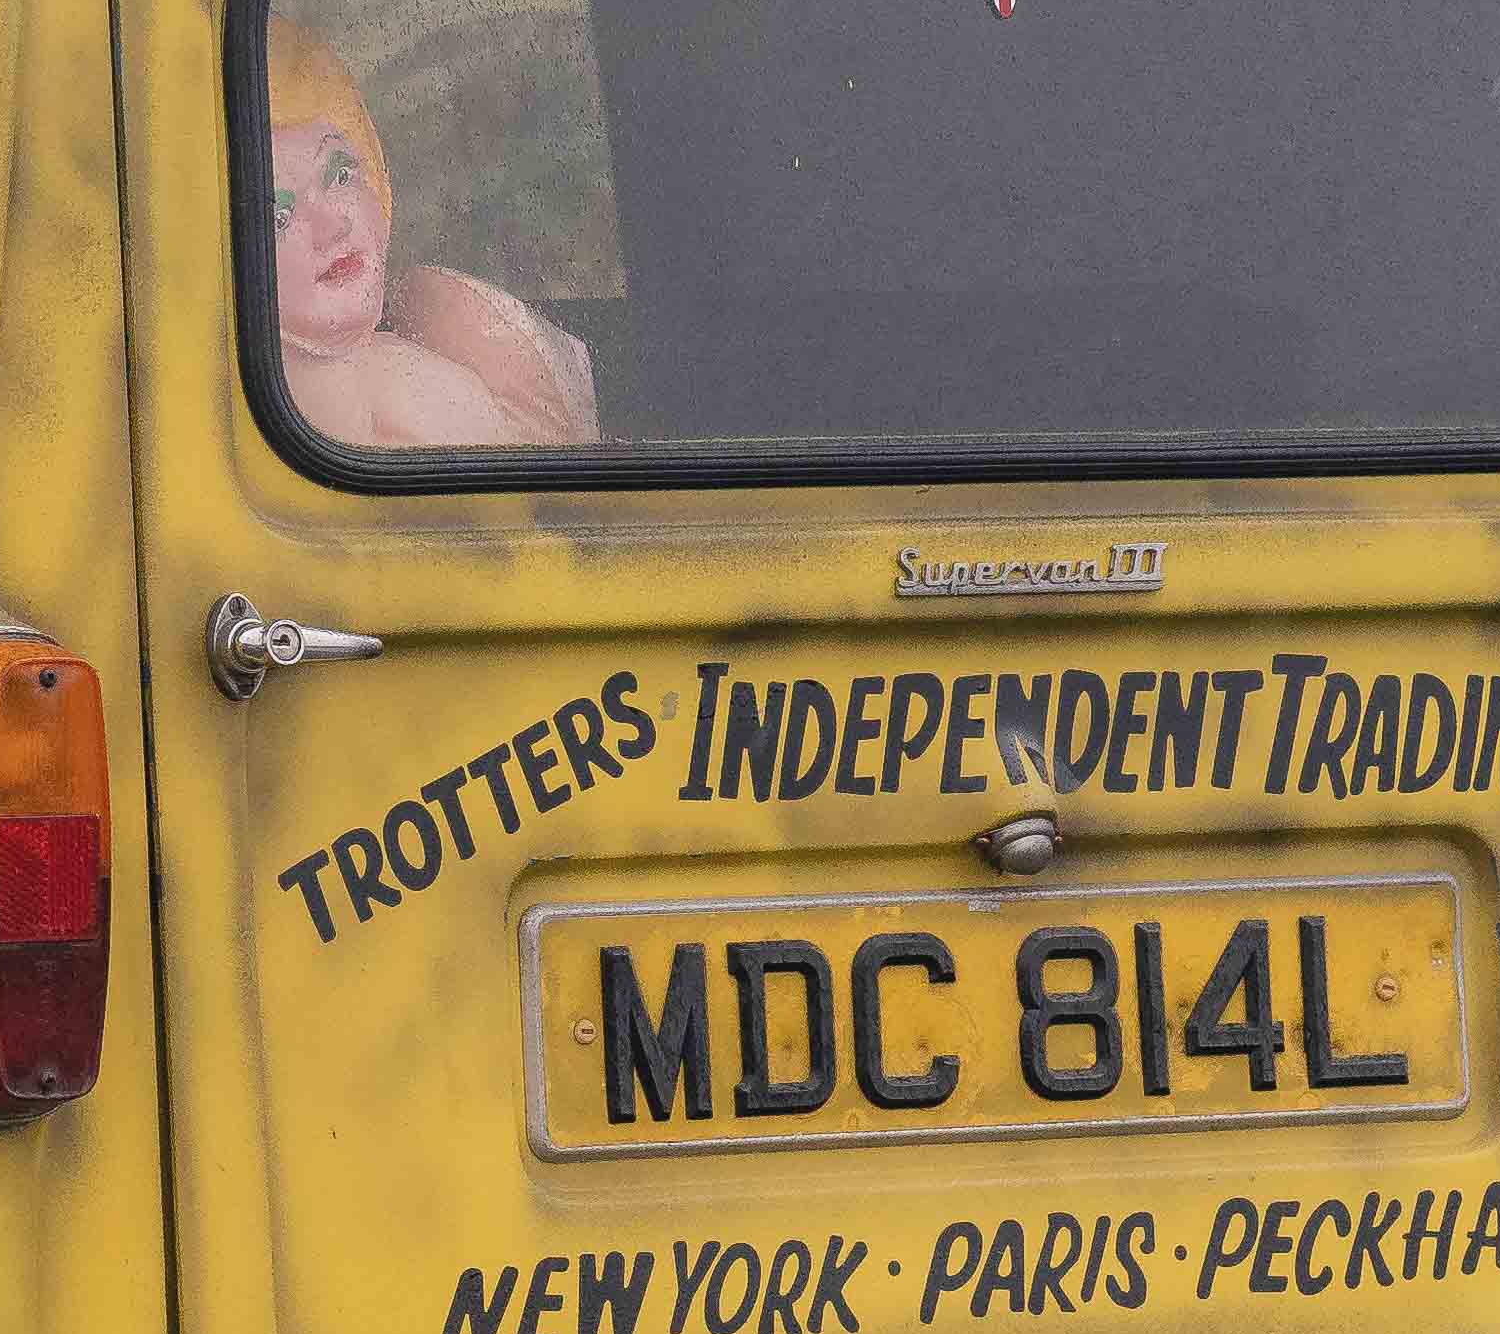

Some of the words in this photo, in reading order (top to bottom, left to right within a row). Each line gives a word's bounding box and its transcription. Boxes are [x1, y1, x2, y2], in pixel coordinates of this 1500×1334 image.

[896, 547, 1103, 592] Supervan
[278, 671, 657, 943] TROTTERS
[678, 662, 1263, 803] INDEPENDENT
[599, 931, 960, 1125] MDC
[1015, 914, 1409, 1103] 814L
[918, 1210, 1157, 1321] PARIS
